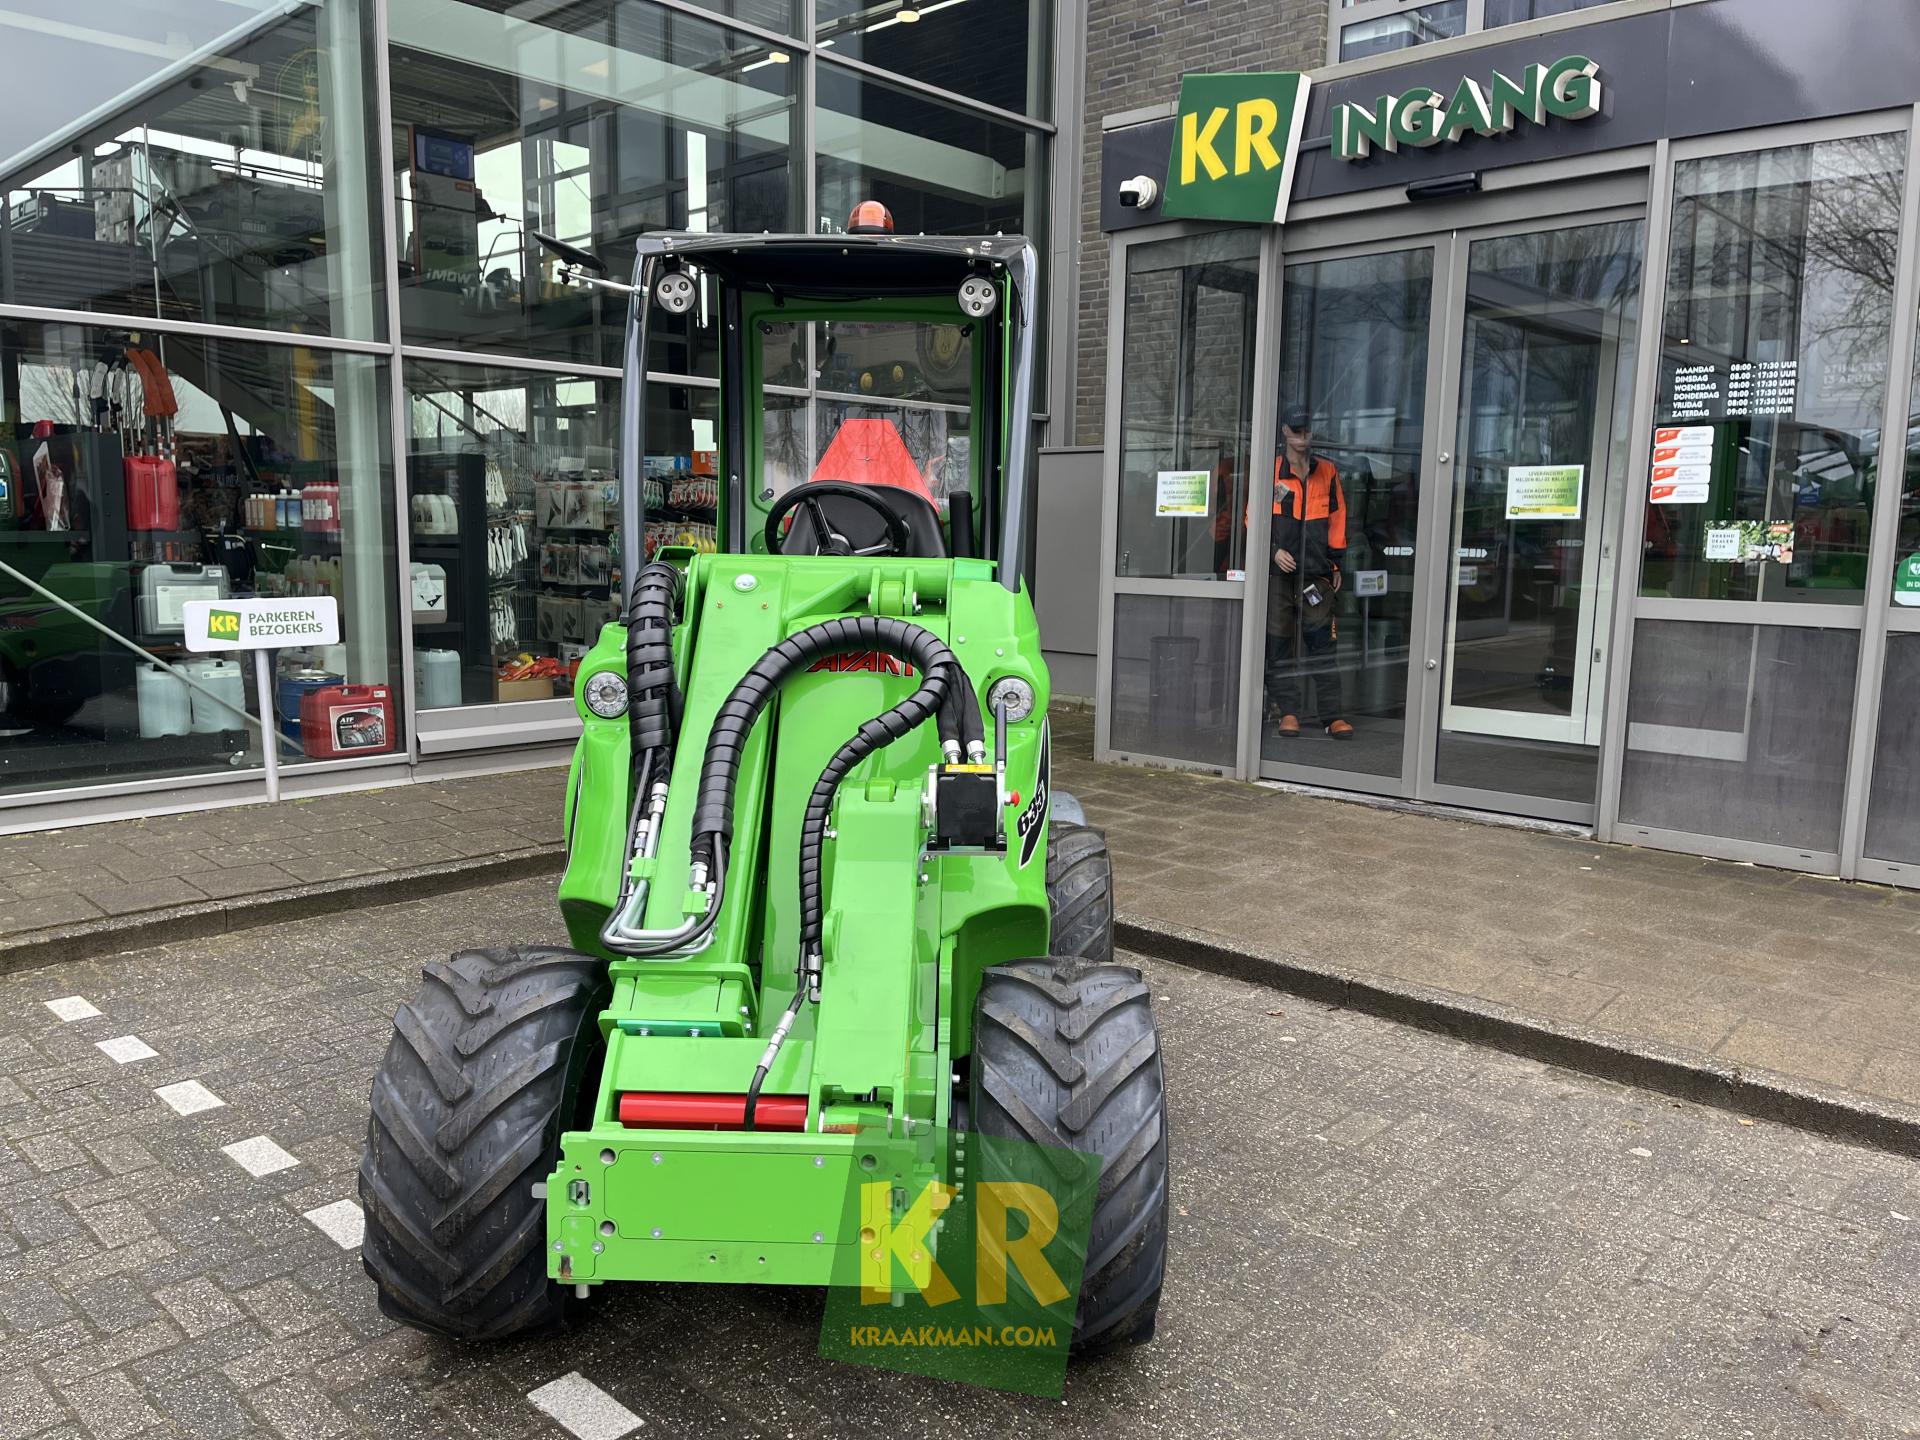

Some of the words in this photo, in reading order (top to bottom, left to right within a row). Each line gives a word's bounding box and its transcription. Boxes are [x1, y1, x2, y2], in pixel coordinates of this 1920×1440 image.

[1331, 55, 1600, 160] INGANG
[1180, 97, 1282, 186] KR
[1676, 365, 1715, 374] MAANDAG
[1731, 363, 1752, 371] 08:00
[1758, 362, 1779, 370] 17:30
[1781, 361, 1797, 369] UUR
[1675, 374, 1709, 383] DINSDAG
[1757, 371, 1778, 379] 17:30
[1780, 370, 1796, 378] UUR
[1674, 382, 1717, 392] WOENSDAG
[1729, 381, 1750, 389] 08:00
[1756, 380, 1778, 388] 17:30
[1779, 379, 1796, 387] UUR
[1673, 391, 1720, 400] DONDERDAG
[1728, 390, 1749, 398] 08:00
[1755, 389, 1777, 397] 17:30
[1778, 388, 1795, 396] UUR
[1673, 400, 1703, 409] VRIJDAG
[1727, 399, 1748, 407] 08:00
[1755, 397, 1776, 405] 17:30
[1777, 397, 1794, 405] UUR
[1672, 409, 1710, 418] ZATERDAG
[1726, 408, 1747, 416] 09:00
[1776, 406, 1793, 414] UUR
[249, 610, 315, 624] PARKEREN
[210, 615, 239, 633] KR
[250, 622, 323, 636] BEZOEKERS
